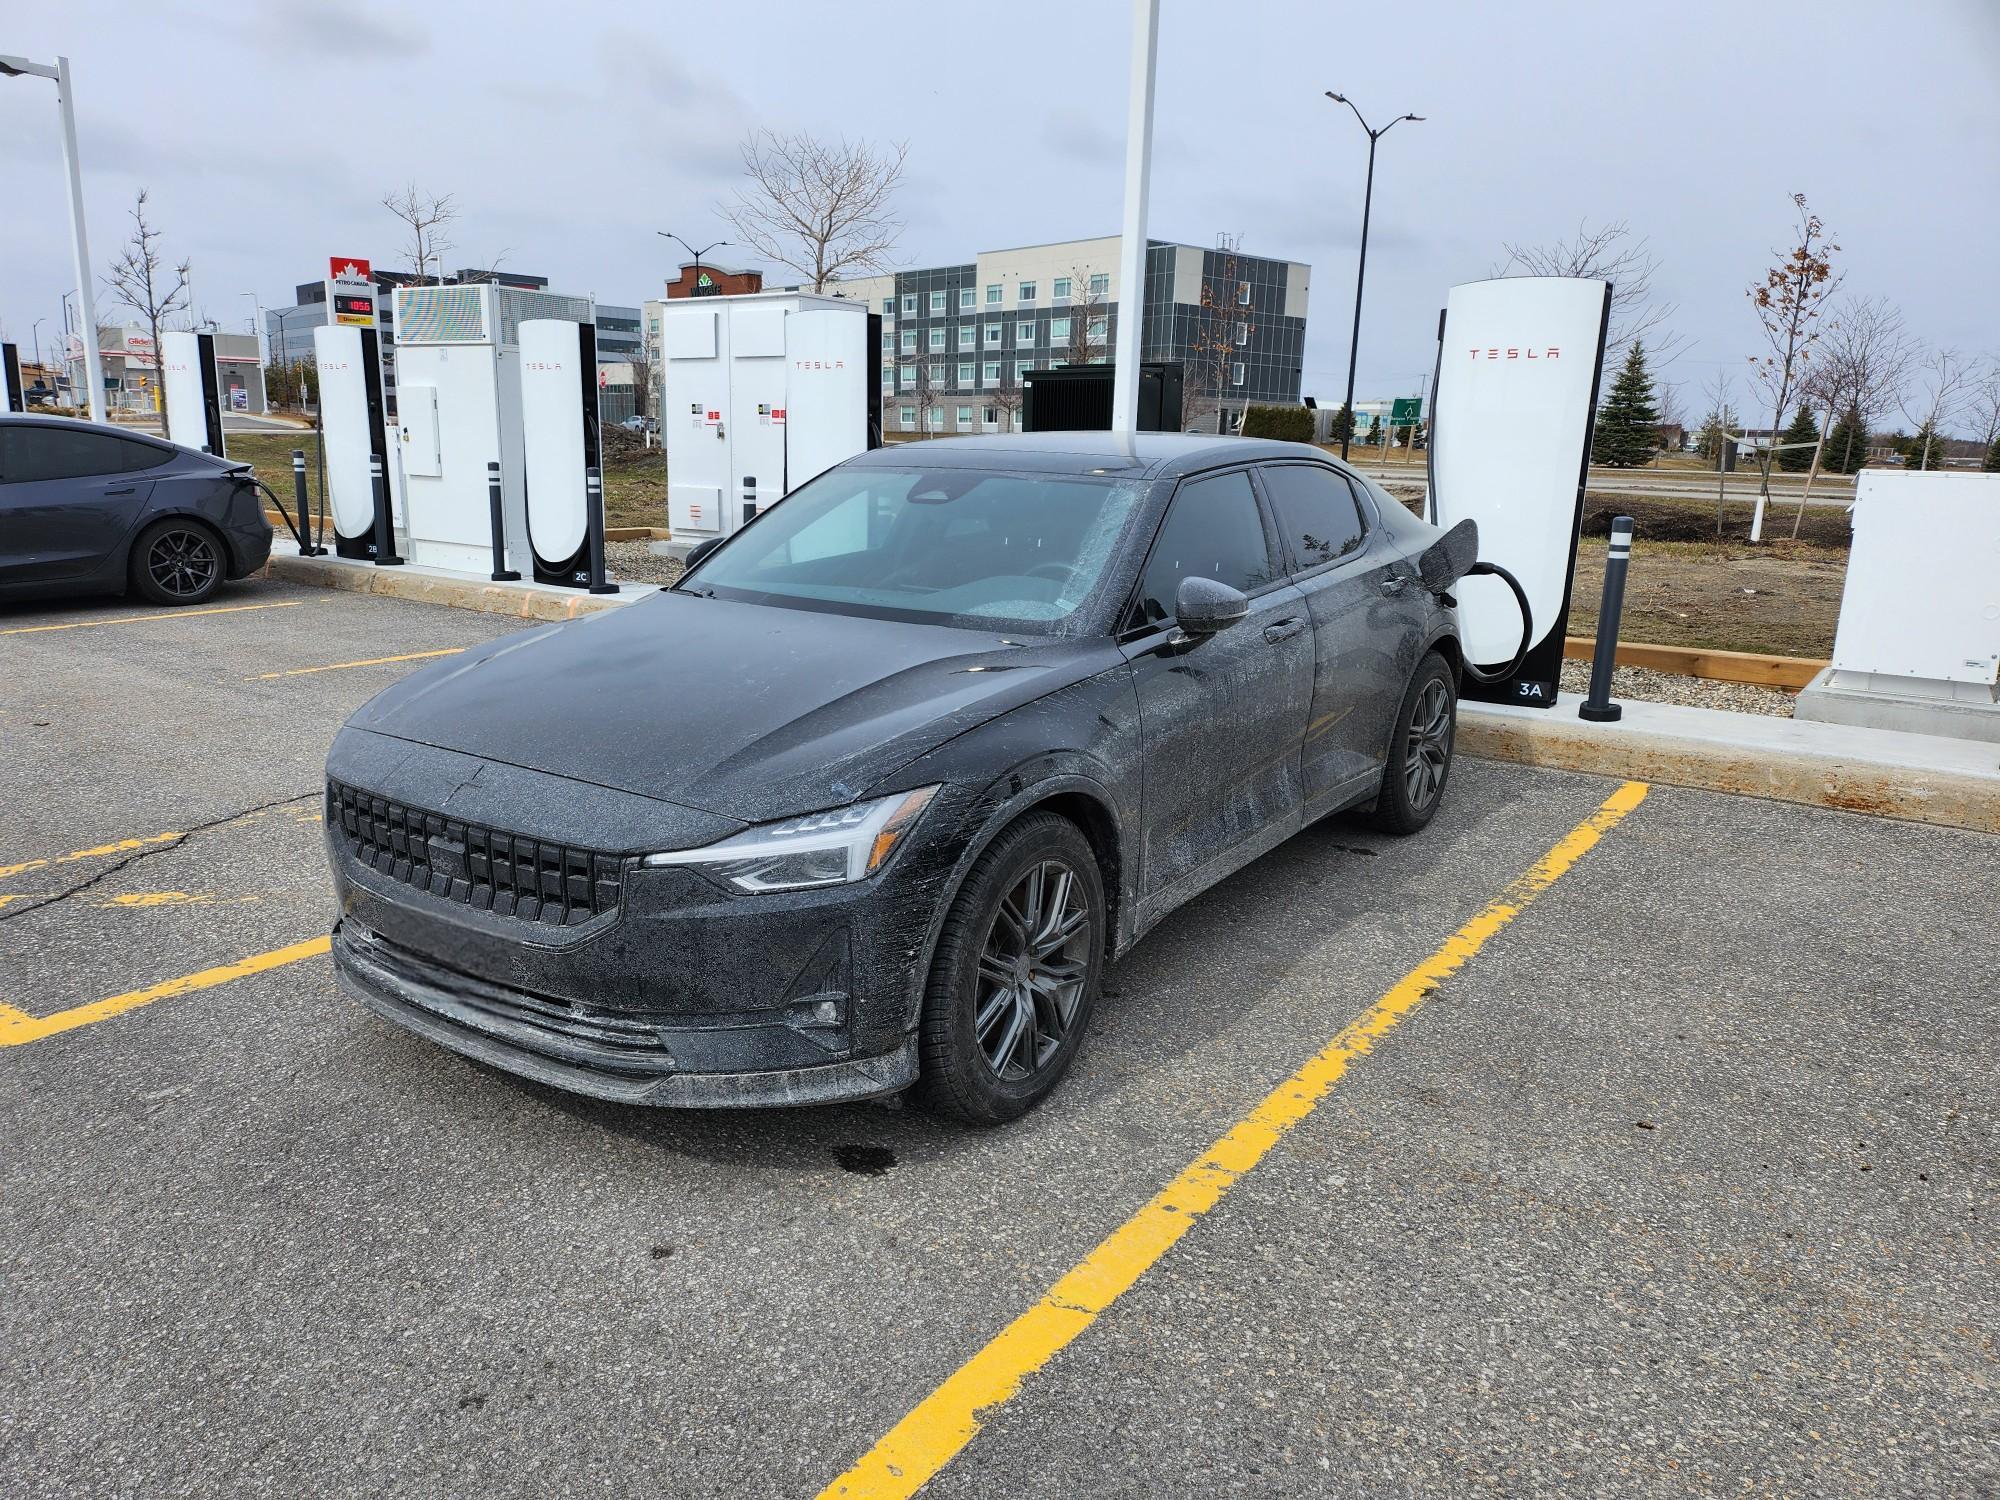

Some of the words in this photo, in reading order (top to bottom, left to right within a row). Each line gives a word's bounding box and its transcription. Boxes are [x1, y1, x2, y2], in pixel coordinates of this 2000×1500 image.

[1469, 347, 1560, 360] TESLA
[526, 362, 562, 371] TESLA
[795, 360, 844, 370] TESLA
[575, 572, 587, 581] 2C
[1519, 682, 1543, 697] 3A
